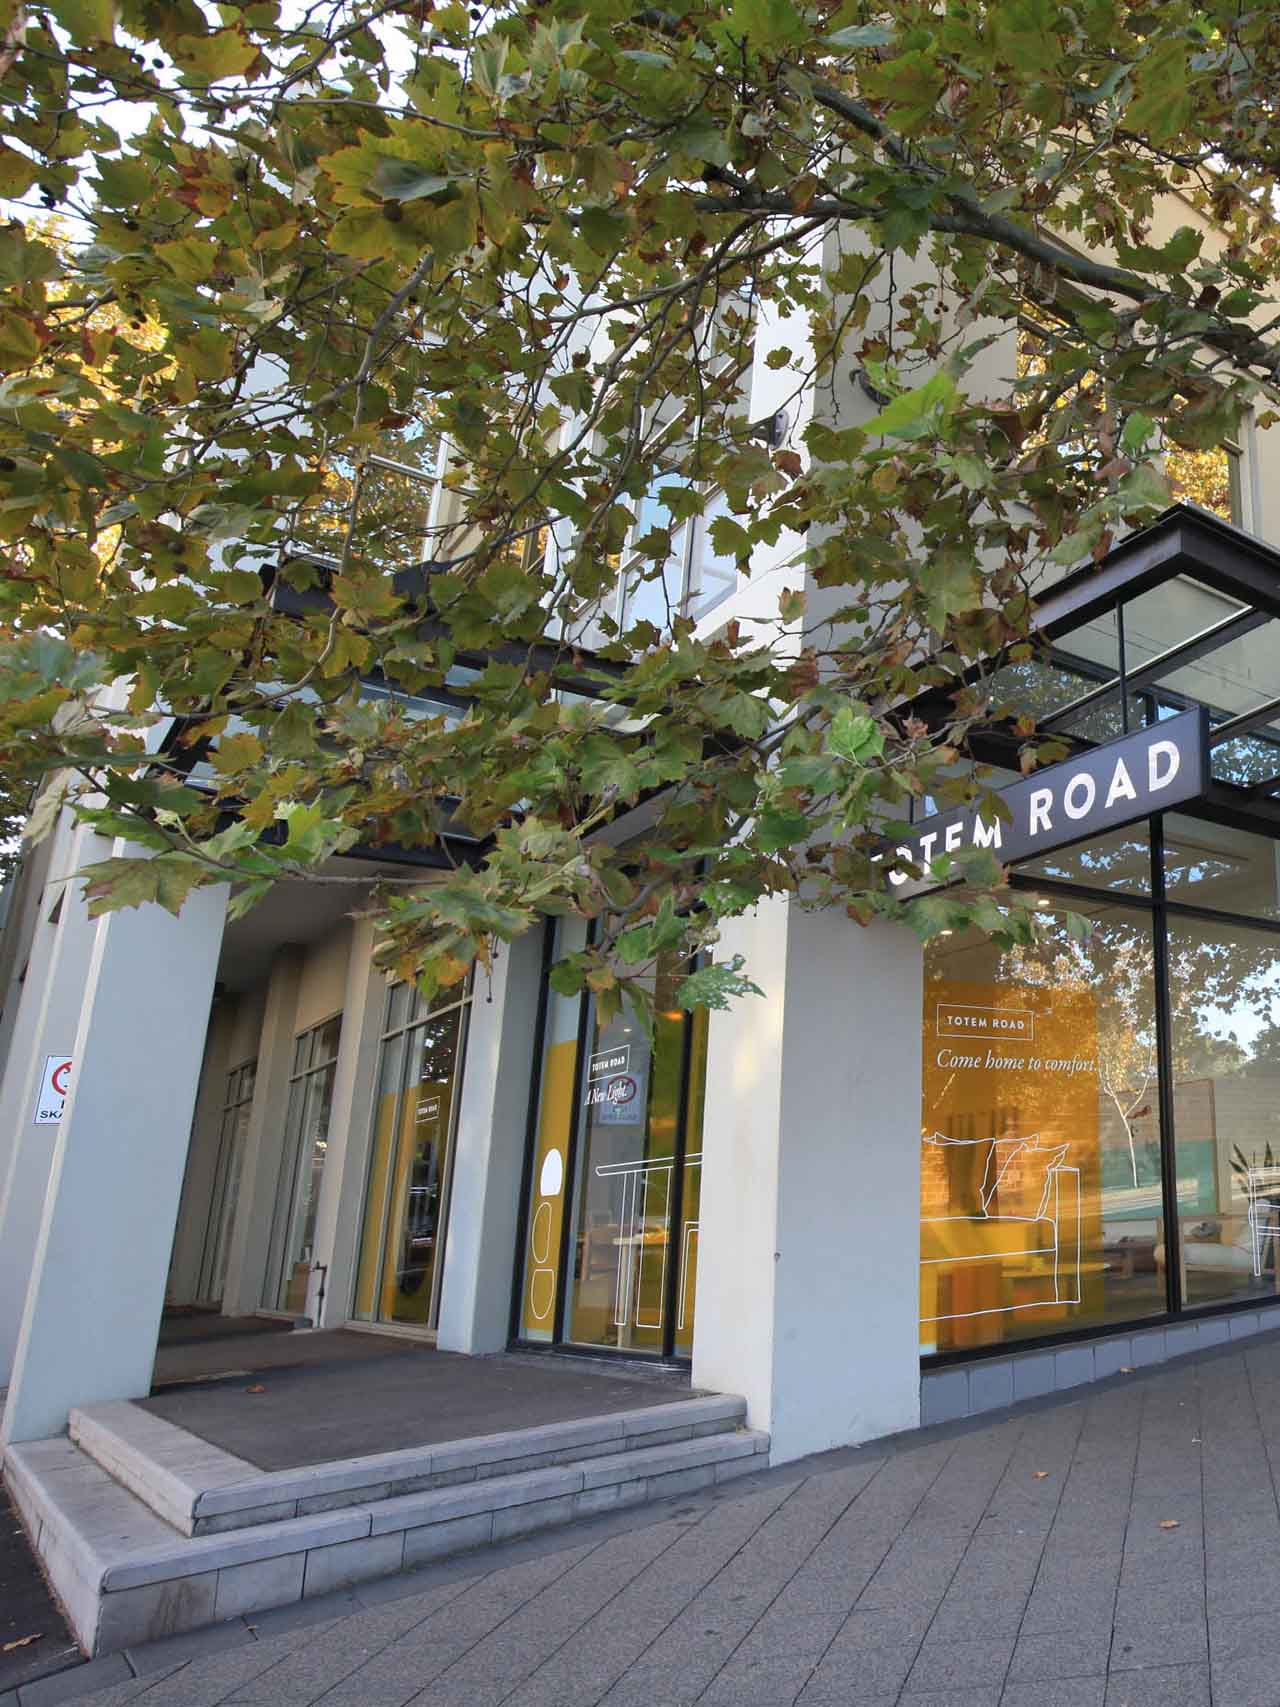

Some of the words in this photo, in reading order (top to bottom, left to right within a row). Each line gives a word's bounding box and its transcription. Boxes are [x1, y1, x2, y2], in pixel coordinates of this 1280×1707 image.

[870, 813, 1002, 885] OTEM
[1029, 740, 1181, 836] ROAD
[947, 1015, 987, 1028] TOTEM
[992, 1019, 1025, 1030] ROAD
[610, 1056, 625, 1067] ROAD
[936, 1048, 982, 1068] Come
[986, 1050, 1024, 1070] home
[1028, 1056, 1041, 1072] to
[1045, 1054, 1098, 1077] comfort.
